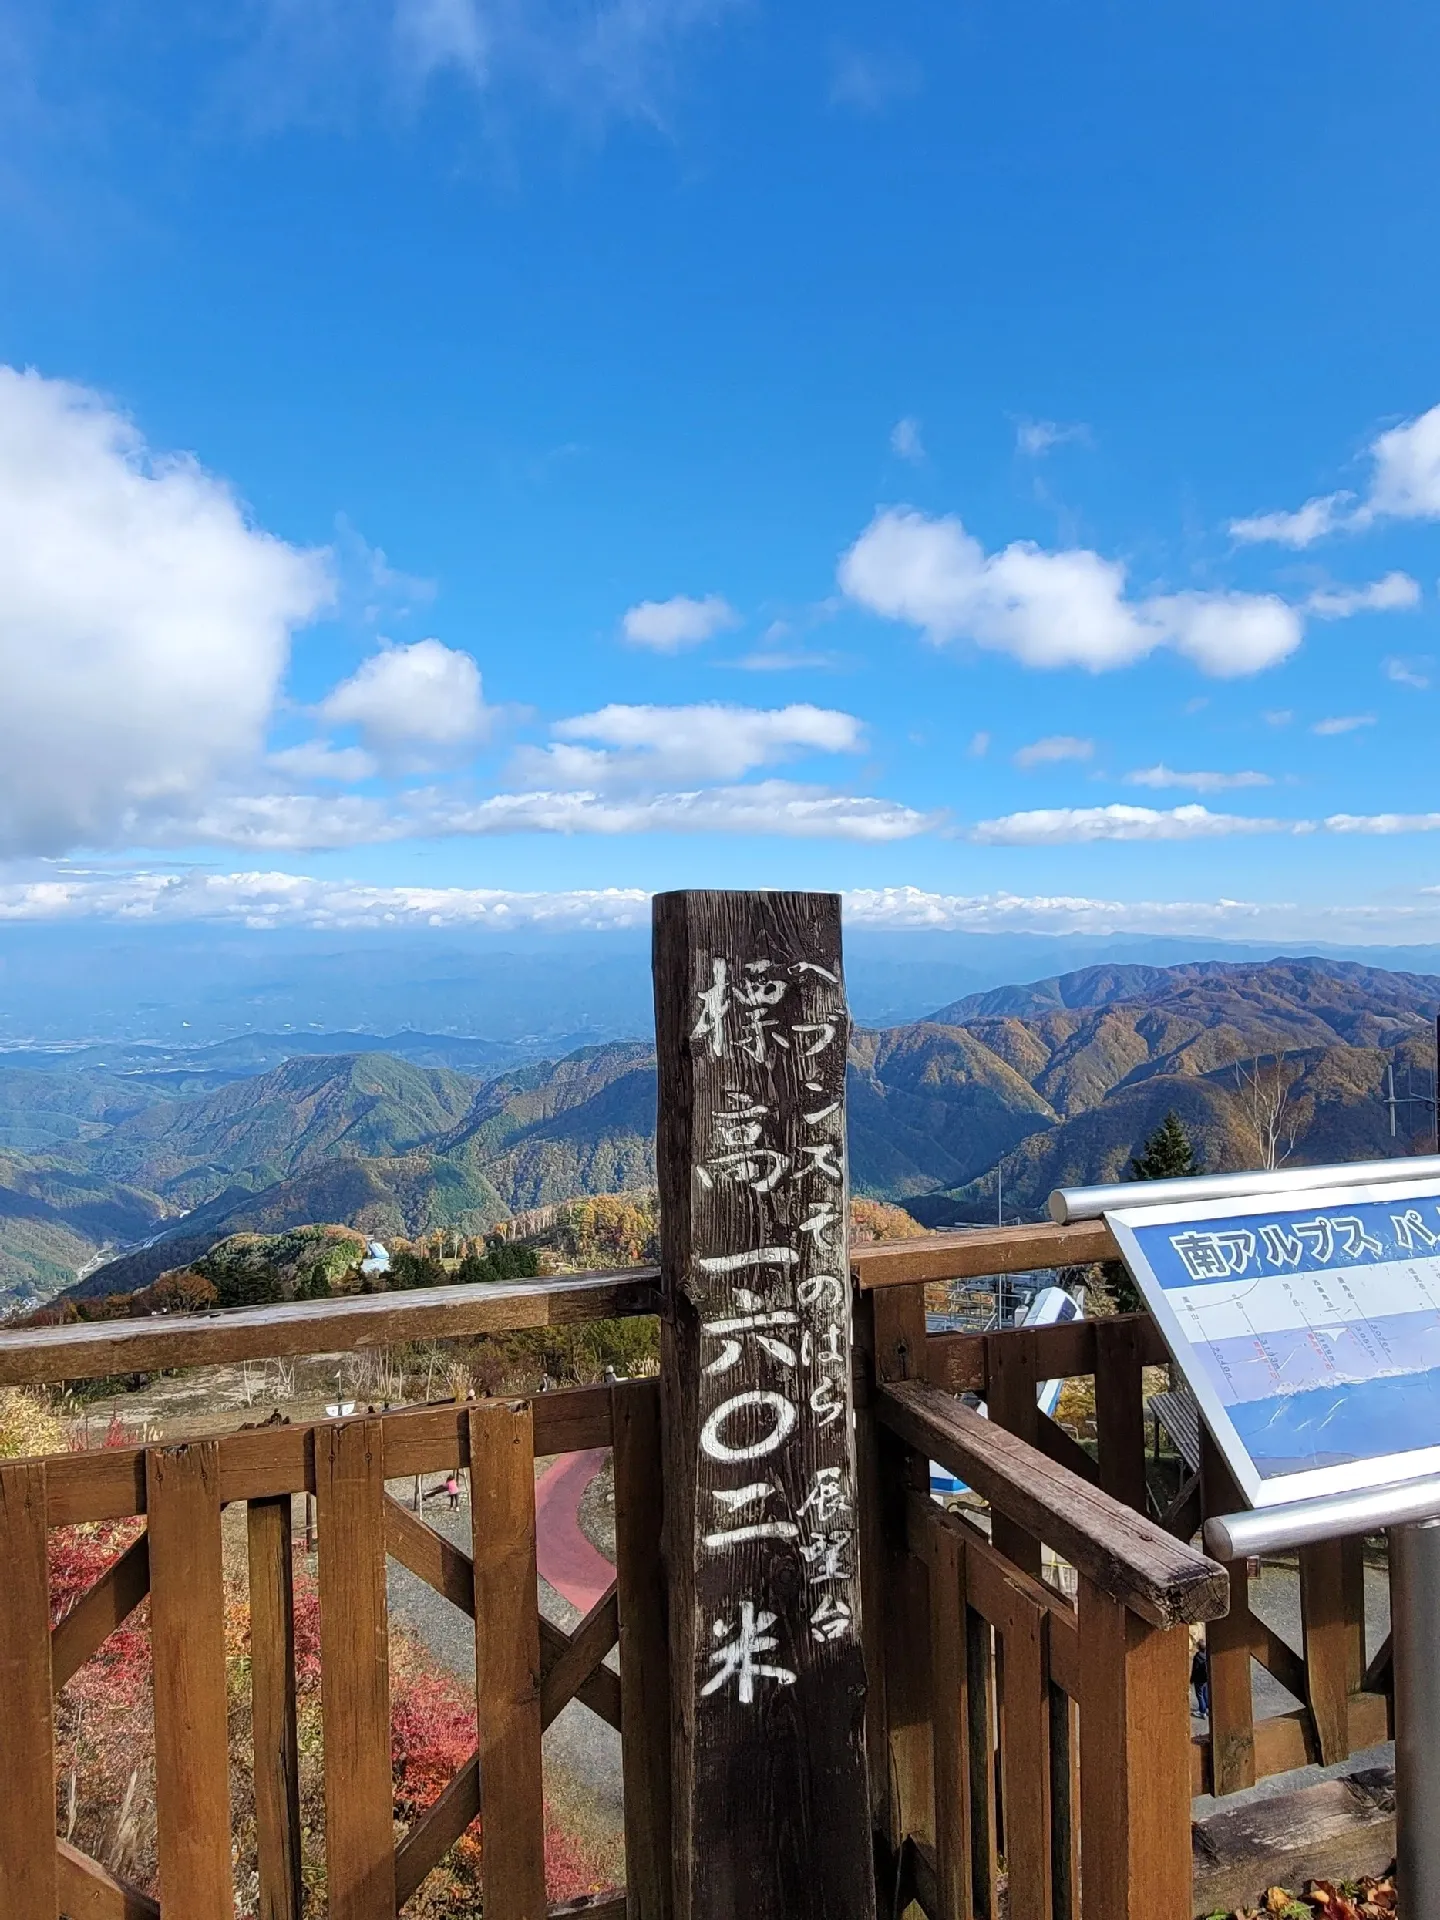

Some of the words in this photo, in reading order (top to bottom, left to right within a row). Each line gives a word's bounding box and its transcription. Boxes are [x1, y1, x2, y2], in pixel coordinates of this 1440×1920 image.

[1169, 1216, 1382, 1280] 南アルプス
[1390, 1206, 1440, 1249] パ
